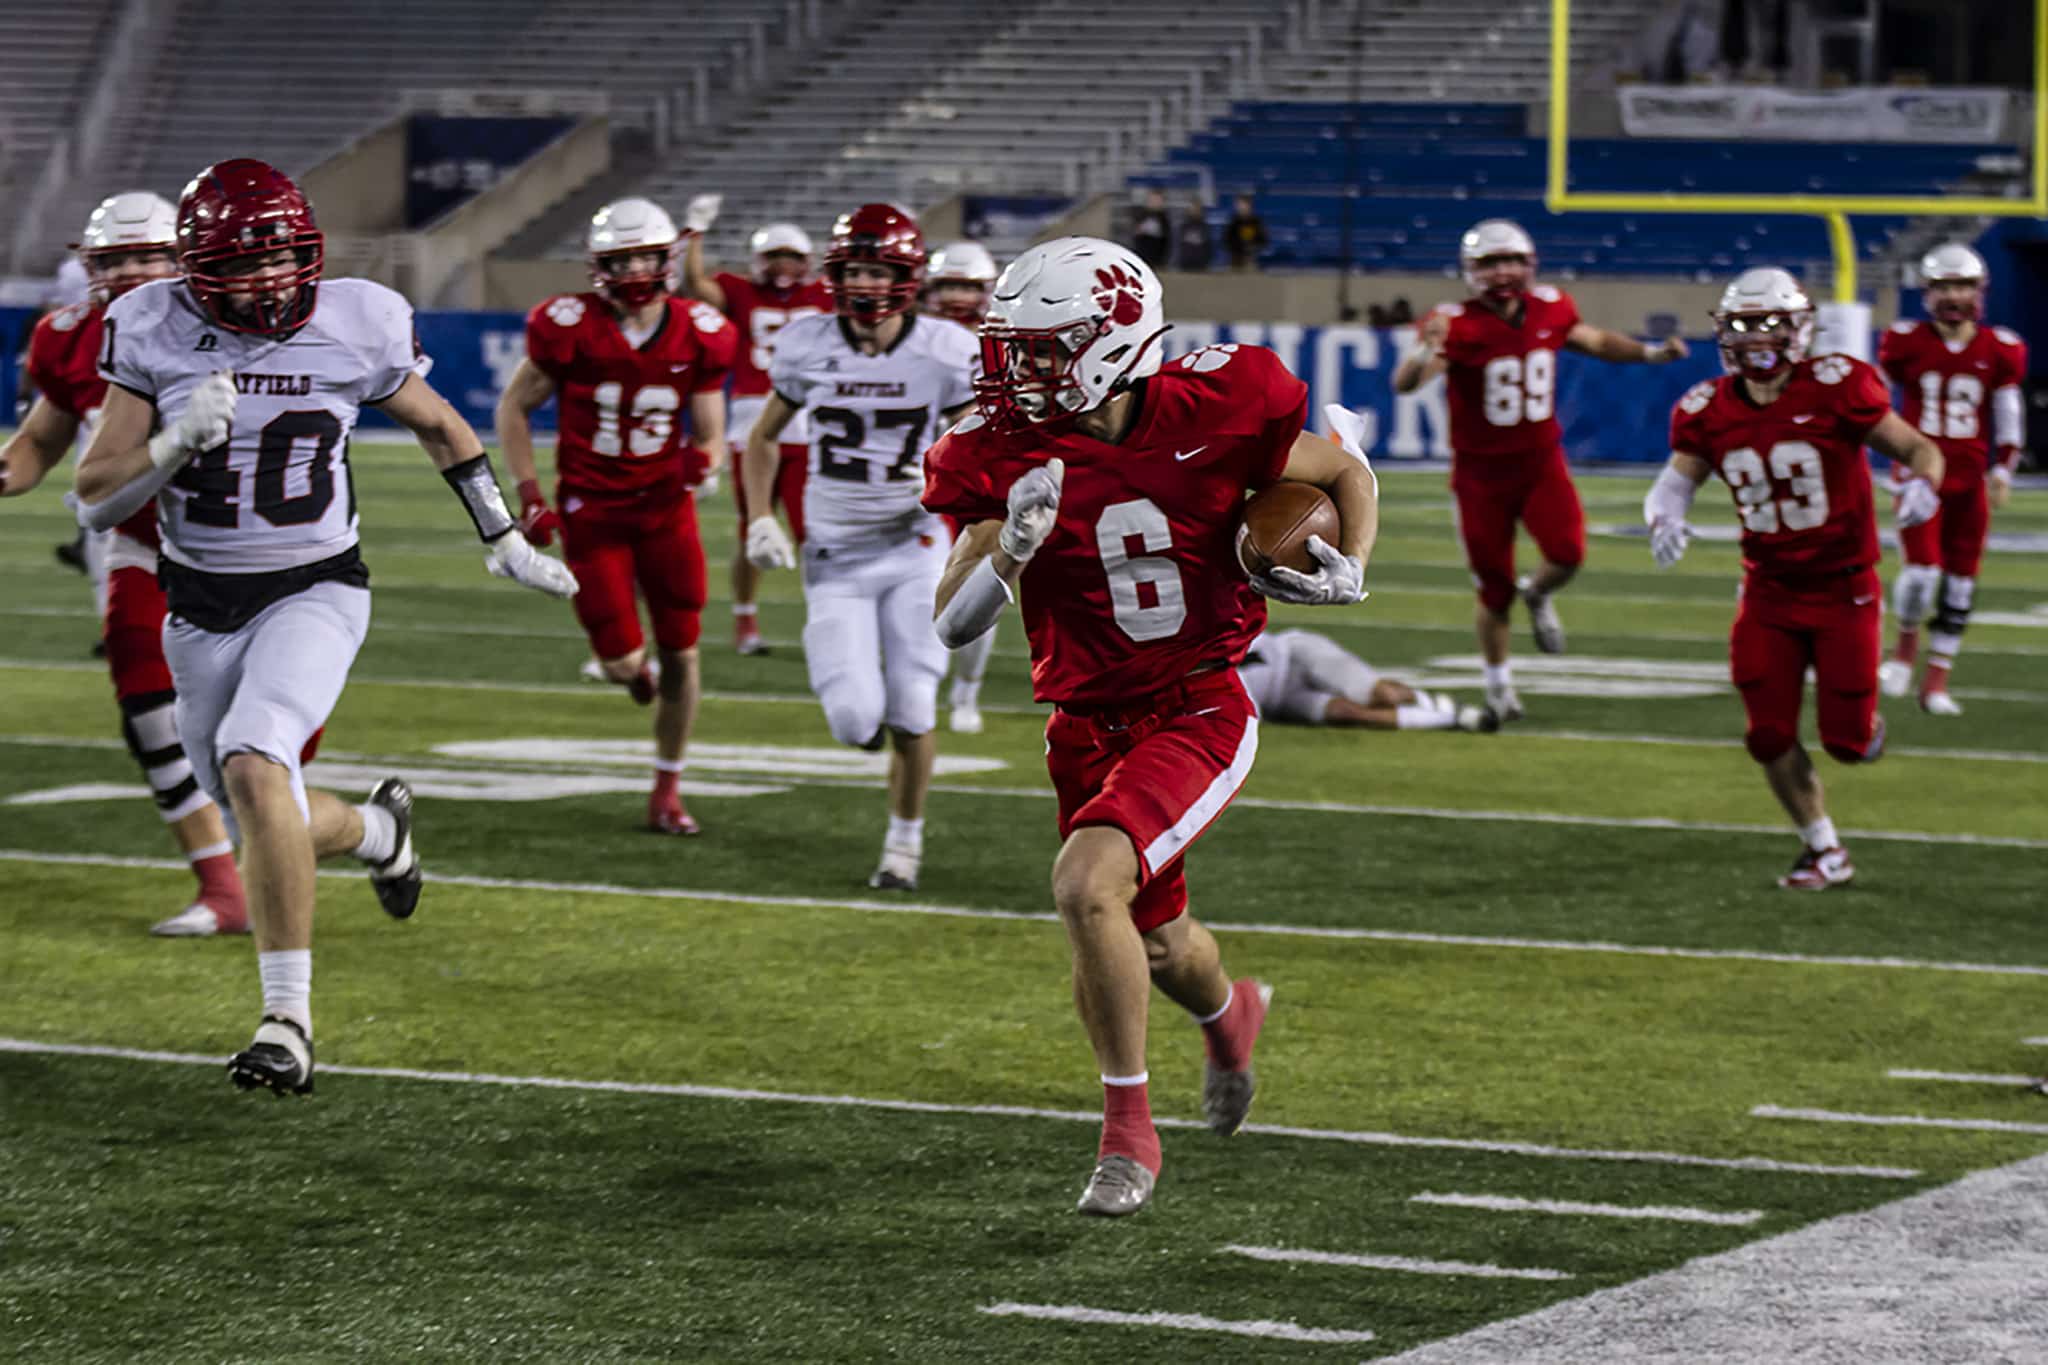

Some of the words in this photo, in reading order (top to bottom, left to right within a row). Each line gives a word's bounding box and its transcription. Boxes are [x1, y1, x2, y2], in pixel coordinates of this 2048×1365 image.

[592, 382, 681, 457] 13
[1484, 348, 1554, 426] 69
[813, 406, 929, 482] 27
[1095, 498, 1188, 642] 6
